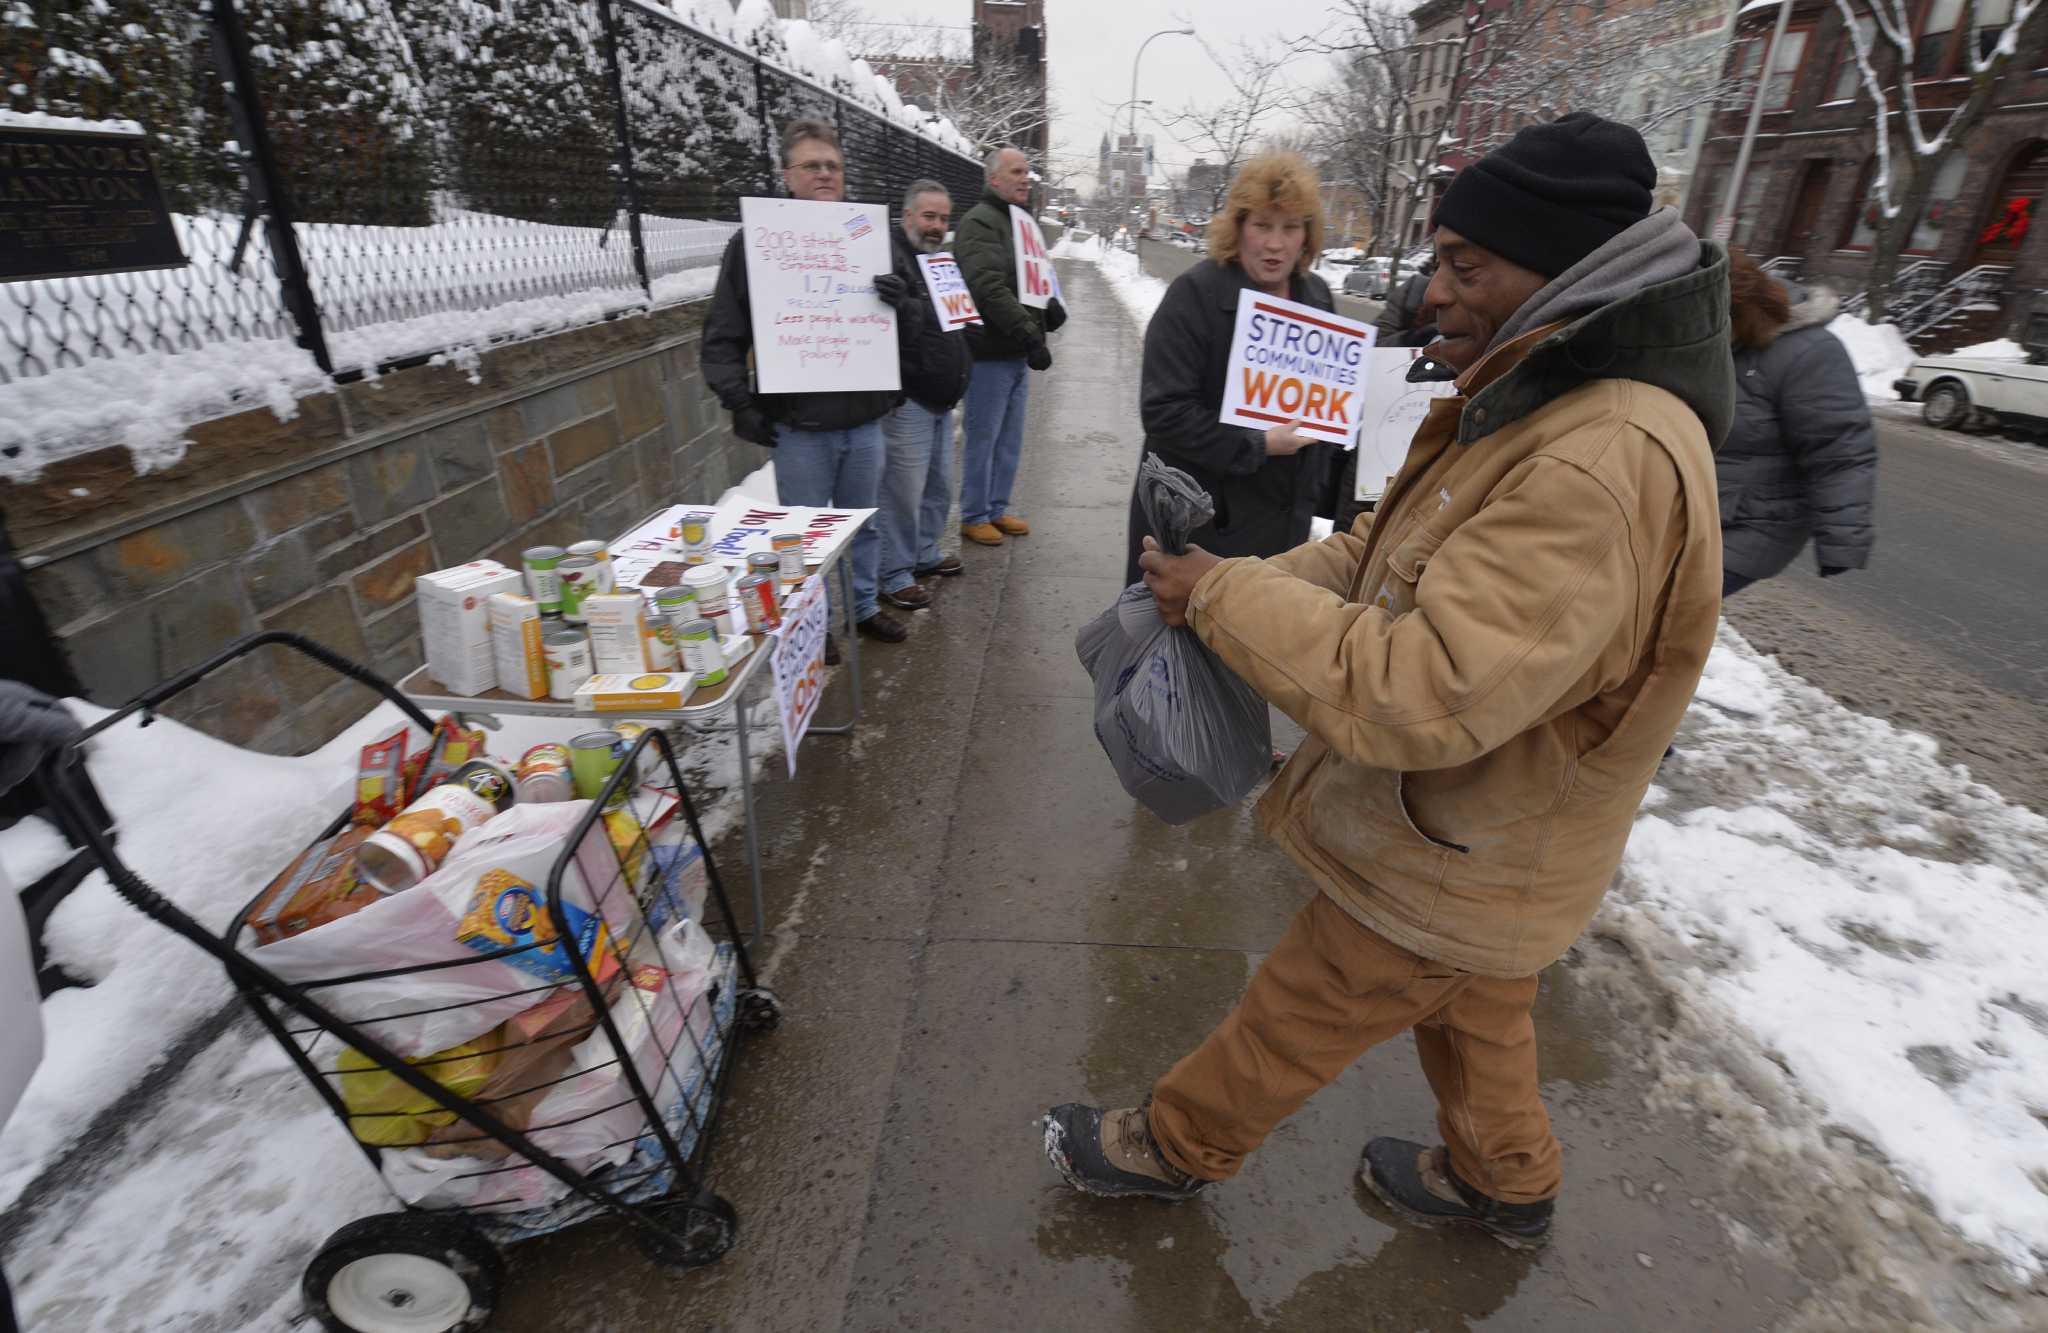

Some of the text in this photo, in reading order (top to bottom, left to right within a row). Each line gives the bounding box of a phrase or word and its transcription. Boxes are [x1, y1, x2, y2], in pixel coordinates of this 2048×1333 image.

[0, 175, 143, 201] ANSION
[1247, 313, 1362, 366] STRONG
[1245, 345, 1358, 386] COMMUNITIES
[1243, 367, 1354, 424] WORK
